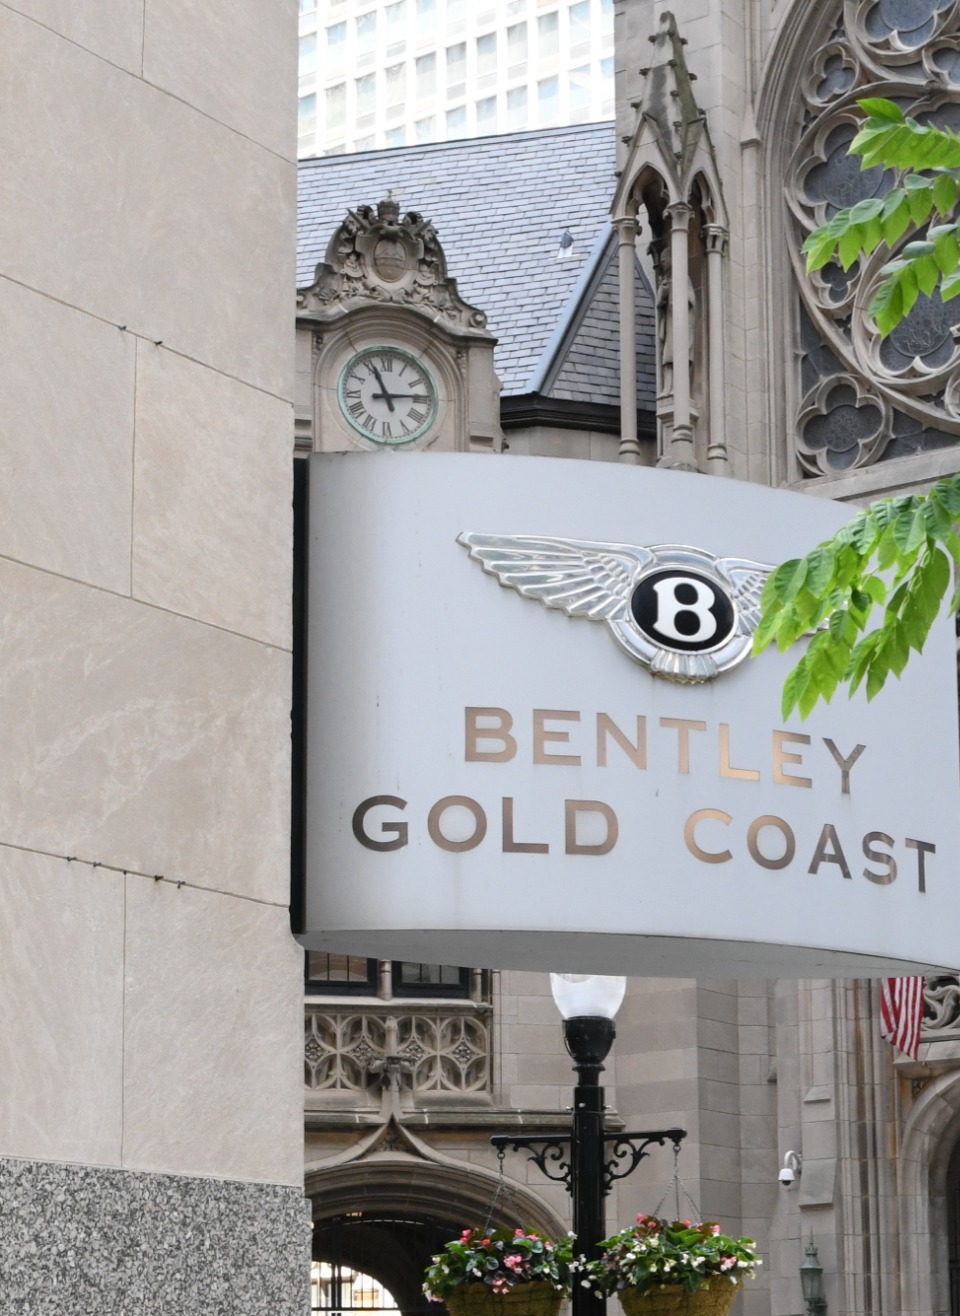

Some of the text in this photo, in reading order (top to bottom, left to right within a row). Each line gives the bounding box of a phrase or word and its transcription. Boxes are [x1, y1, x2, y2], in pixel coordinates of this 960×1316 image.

[350, 372, 366, 385] X
[381, 358, 393, 373] XII
[653, 576, 718, 643] B
[464, 706, 866, 795] BENTLEY
[351, 794, 936, 893] GOLD COAST
